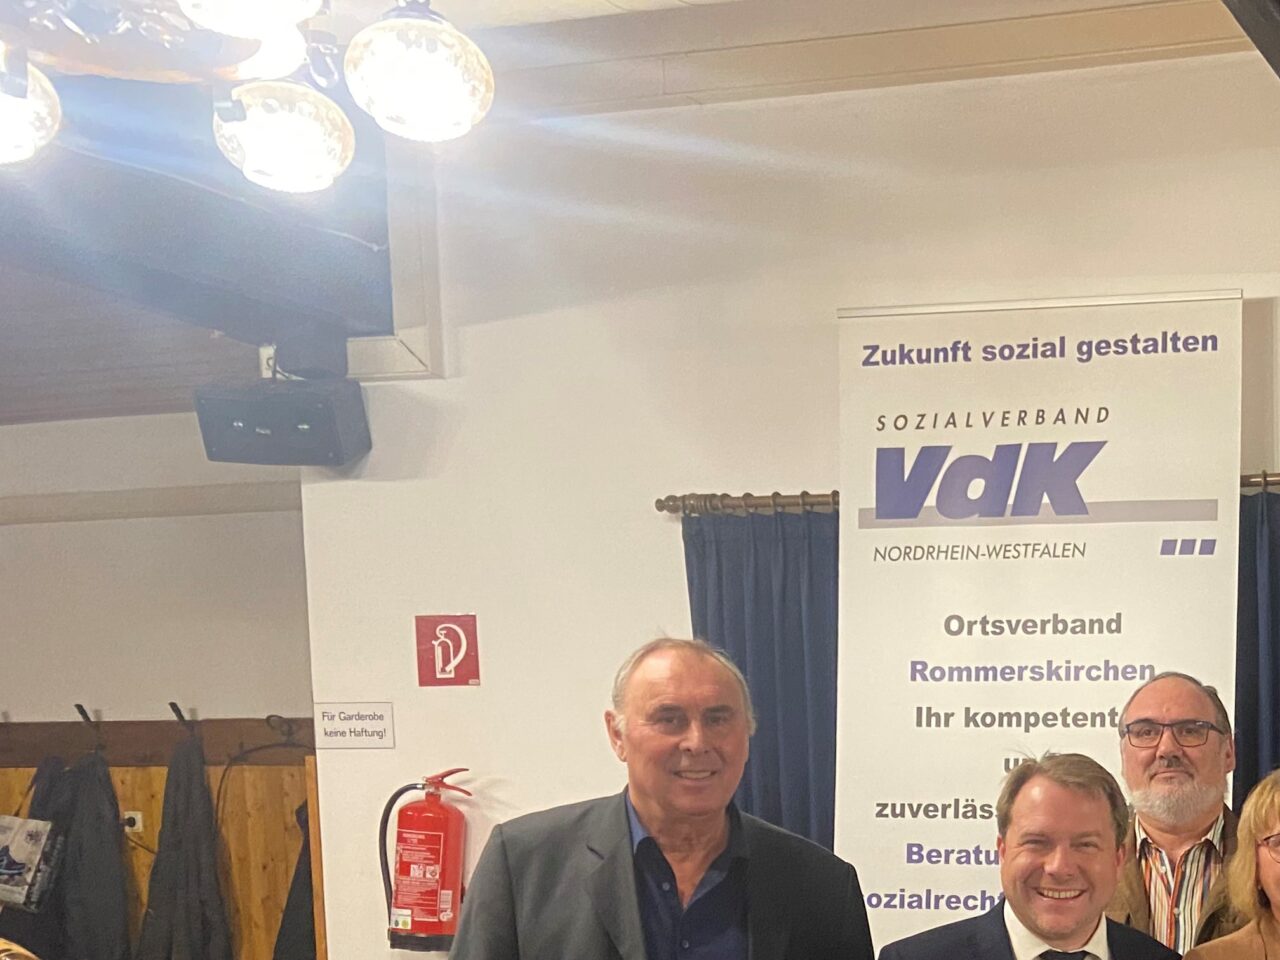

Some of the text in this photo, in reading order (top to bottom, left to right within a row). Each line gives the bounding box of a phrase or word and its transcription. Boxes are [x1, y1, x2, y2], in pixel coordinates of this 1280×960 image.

[862, 331, 1218, 367] Zukunft sozial gestalten
[875, 407, 1110, 431] SOZIALVERBAND
[875, 440, 1108, 520] VdK
[872, 542, 1087, 563] NORDRHEIN-WESTFALEN
[943, 612, 1123, 636] Ortsverband
[909, 659, 1156, 682] Rommerskirchen
[321, 711, 385, 721] Für Garderobe
[915, 706, 1119, 732] Ihr kompetent
[323, 728, 387, 740] keine Haftung!
[875, 798, 999, 819] zuverläs
[905, 842, 1000, 865] Beratu
[863, 888, 1004, 911] ozialrech
